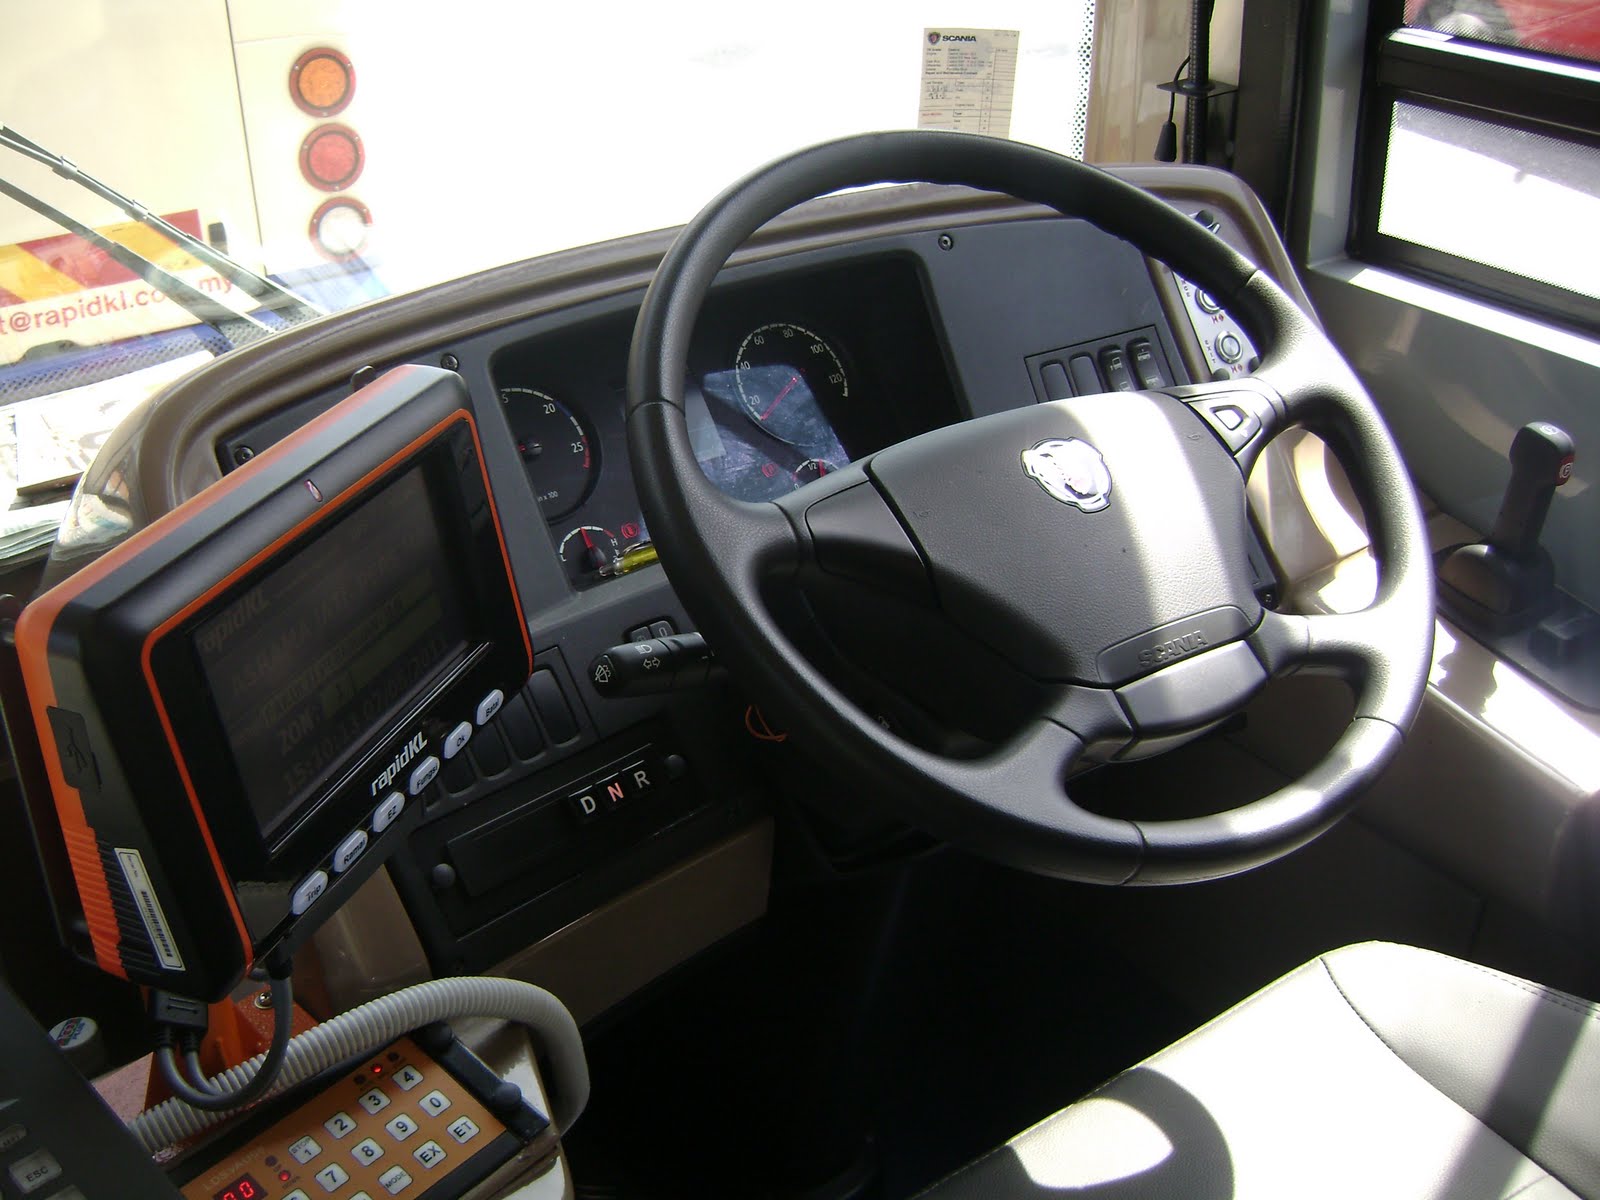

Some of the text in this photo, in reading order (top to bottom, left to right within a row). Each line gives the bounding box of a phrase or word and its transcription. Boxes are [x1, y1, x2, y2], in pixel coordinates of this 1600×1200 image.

[783, 328, 794, 339] 80
[754, 335, 765, 346] 60
[810, 343, 824, 354] 100
[740, 360, 751, 371] 40
[829, 373, 843, 385] 120
[749, 394, 761, 406] 20
[543, 402, 556, 415] 20
[571, 441, 584, 454] 25
[1138, 629, 1209, 667] SCANIA
[371, 731, 428, 797] rapidKL
[416, 764, 438, 790] Fungsi
[579, 769, 651, 815] D N R
[305, 884, 322, 902] Trip
[403, 1071, 415, 1082] 4
[368, 1094, 382, 1106] 3
[429, 1097, 442, 1108] 0
[334, 1118, 349, 1132] 2
[395, 1121, 409, 1133] 9
[453, 1120, 472, 1138] ET
[304, 1148, 312, 1157] 1
[361, 1145, 375, 1158] 8
[419, 1145, 441, 1163] EX
[26, 1165, 49, 1182] ESC
[325, 1168, 337, 1183] 7
[384, 1170, 407, 1189] MODE
